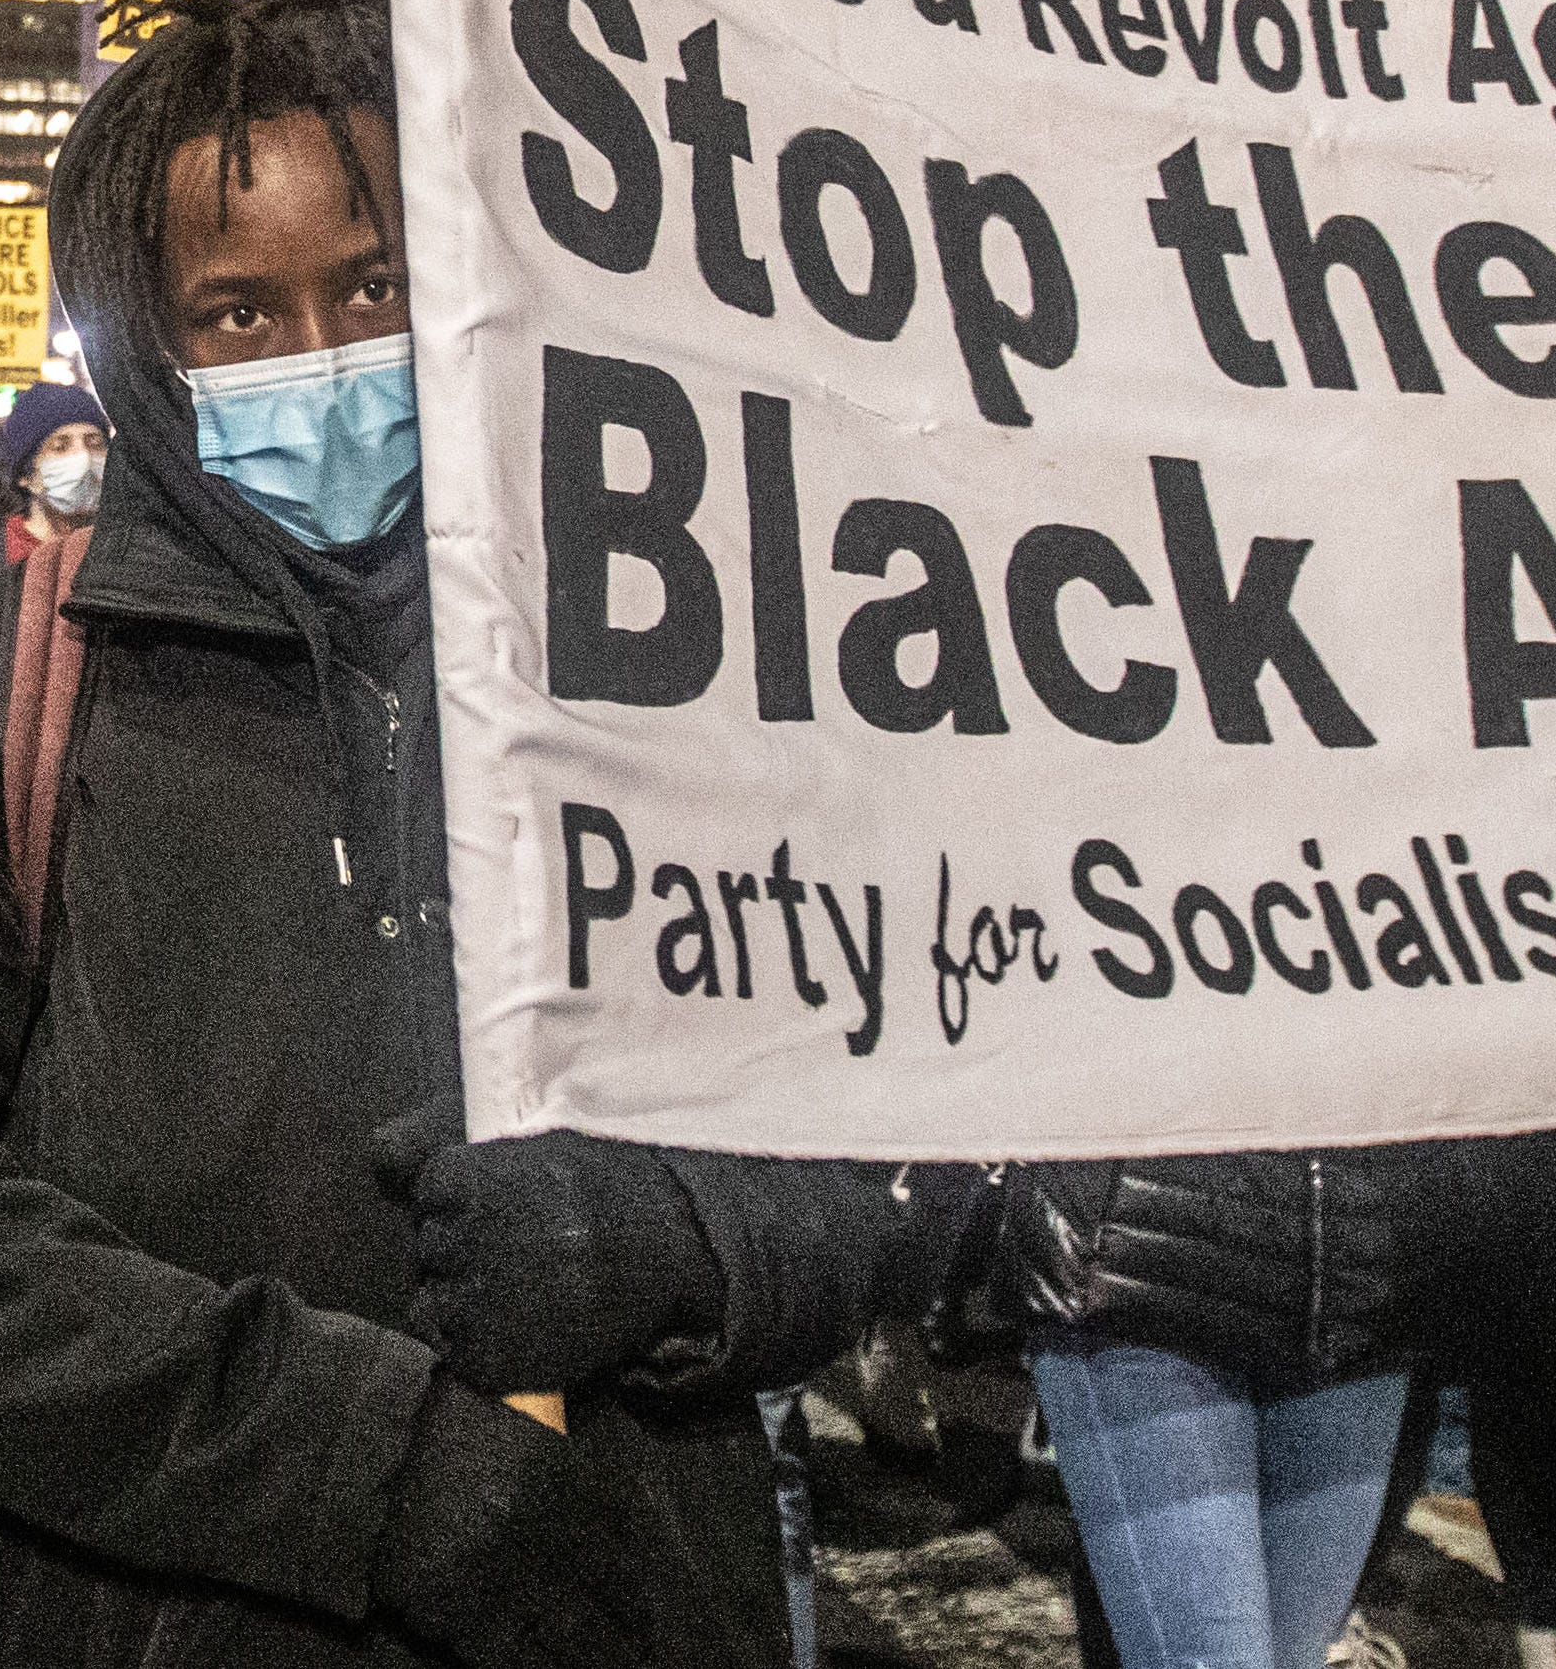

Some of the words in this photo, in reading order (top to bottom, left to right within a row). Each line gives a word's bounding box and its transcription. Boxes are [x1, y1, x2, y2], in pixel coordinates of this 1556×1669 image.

[541, 343, 1378, 749] Black
[560, 800, 884, 1057] Party
[930, 851, 1059, 1045] for
